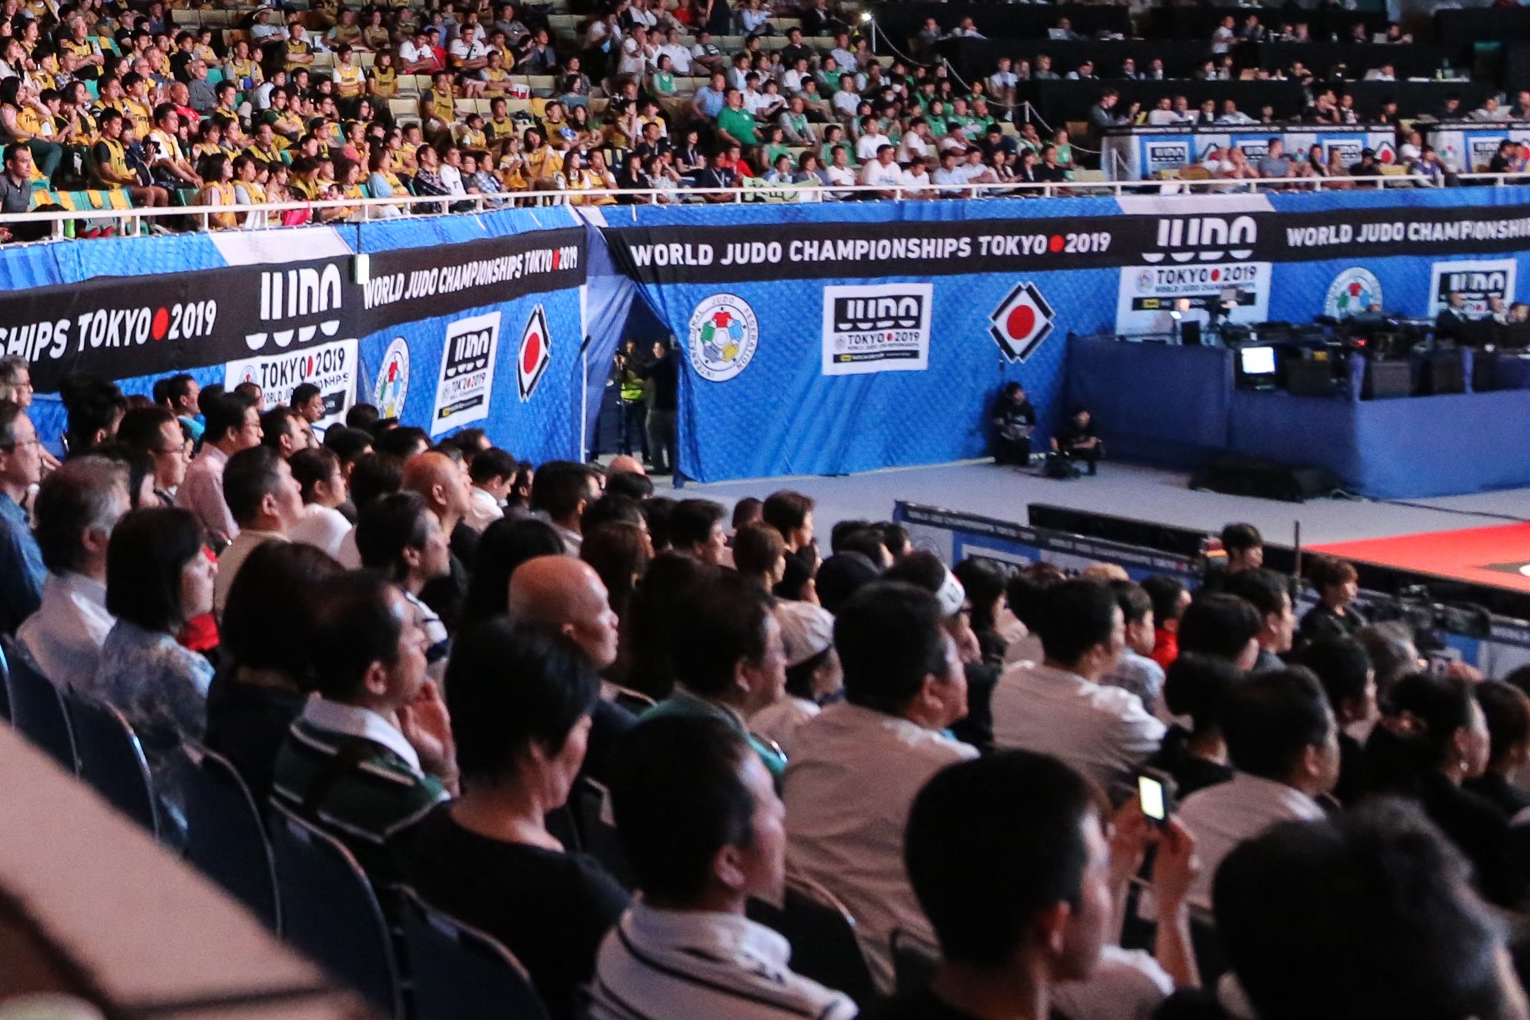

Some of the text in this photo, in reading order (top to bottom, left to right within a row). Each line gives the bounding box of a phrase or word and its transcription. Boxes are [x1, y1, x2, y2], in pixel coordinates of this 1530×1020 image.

[630, 232, 1112, 267] WORLD JUDO CHAMPIONSHIPS TOKYO 2019
[1286, 224, 1353, 247] WORLD
[1356, 222, 1406, 243] JUDO
[363, 245, 578, 309] WORLD JUDO CHAMPIONSHIPS TOKYO 2019
[1157, 266, 1257, 285] TOKYO 2019
[77, 307, 152, 351] TOKYO
[168, 299, 218, 340] 2019
[847, 331, 920, 345] TOKYO 2019
[261, 356, 306, 389] TOKYO
[315, 347, 345, 377] 2019
